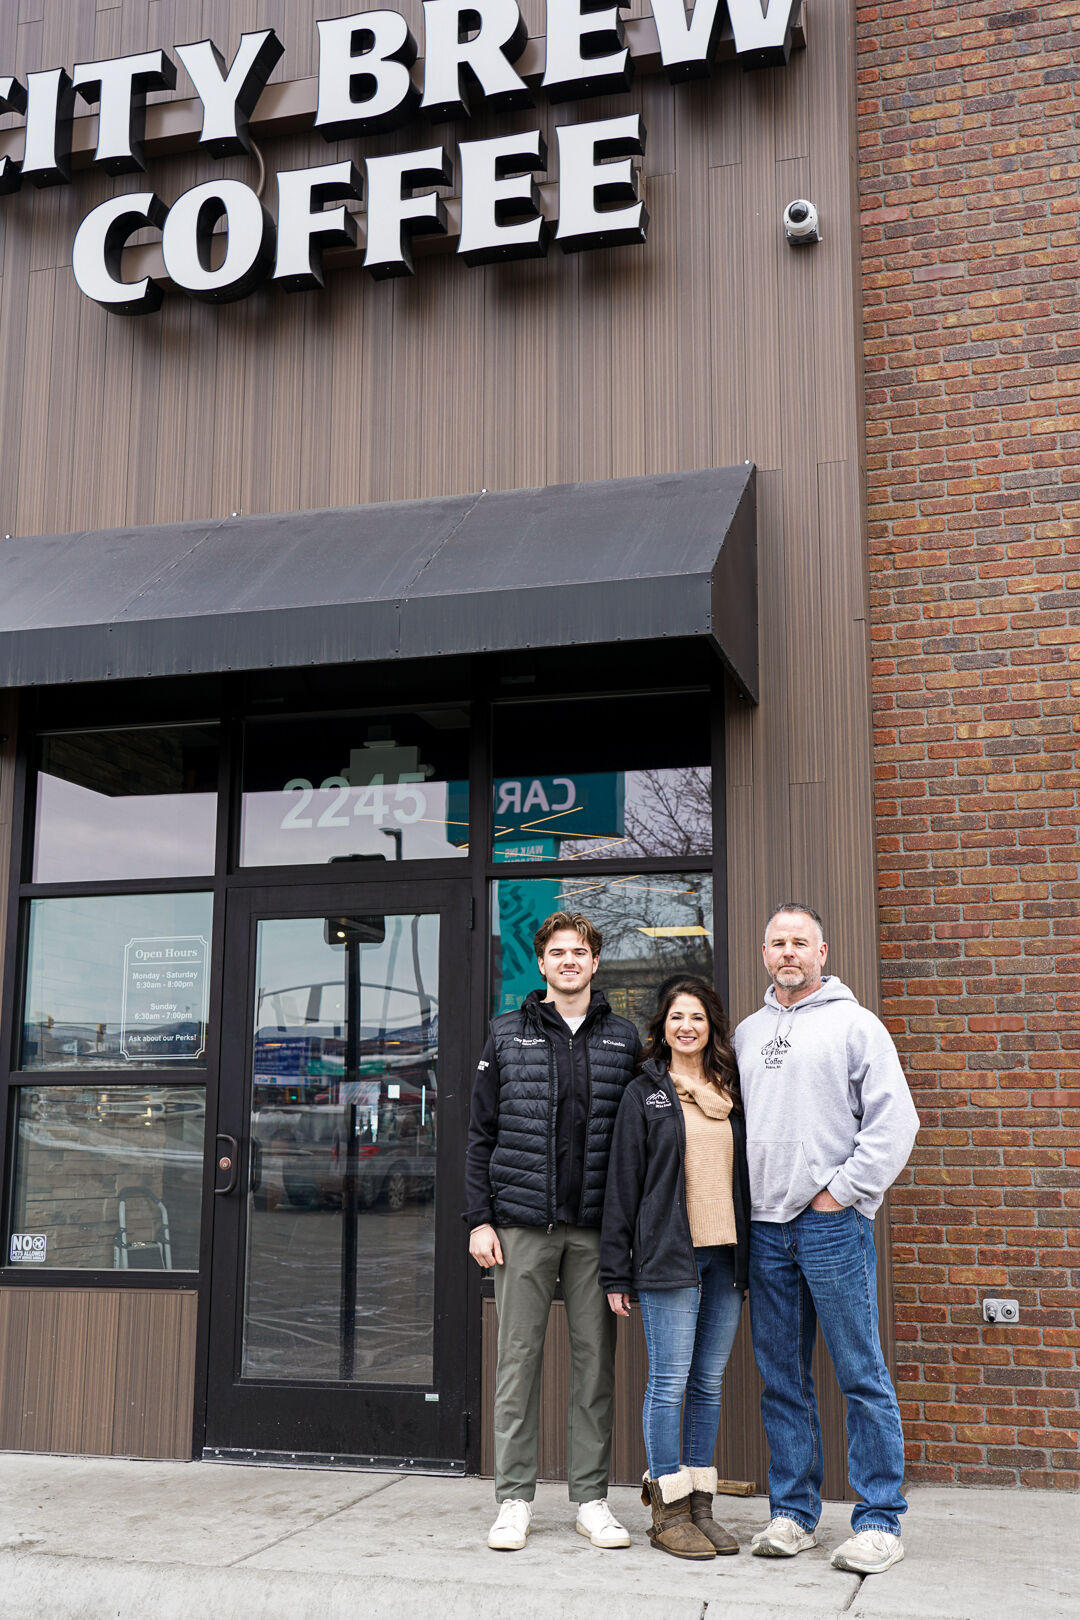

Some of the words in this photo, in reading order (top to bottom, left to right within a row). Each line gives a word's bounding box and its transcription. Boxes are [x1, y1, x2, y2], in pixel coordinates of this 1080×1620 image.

[0, 28, 278, 182] ITY
[72, 113, 646, 306] COFFEE
[280, 772, 427, 829] 2245
[135, 949, 163, 961] Open
[165, 948, 198, 958] Hours
[132, 972, 160, 980] Monday
[166, 971, 198, 979] Saturday
[167, 981, 193, 989] 8:00pm
[150, 1003, 177, 1011] Sunday
[166, 1012, 192, 1020] 7:00pm
[764, 1057, 783, 1065] Coffee
[13, 1235, 32, 1250] NO
